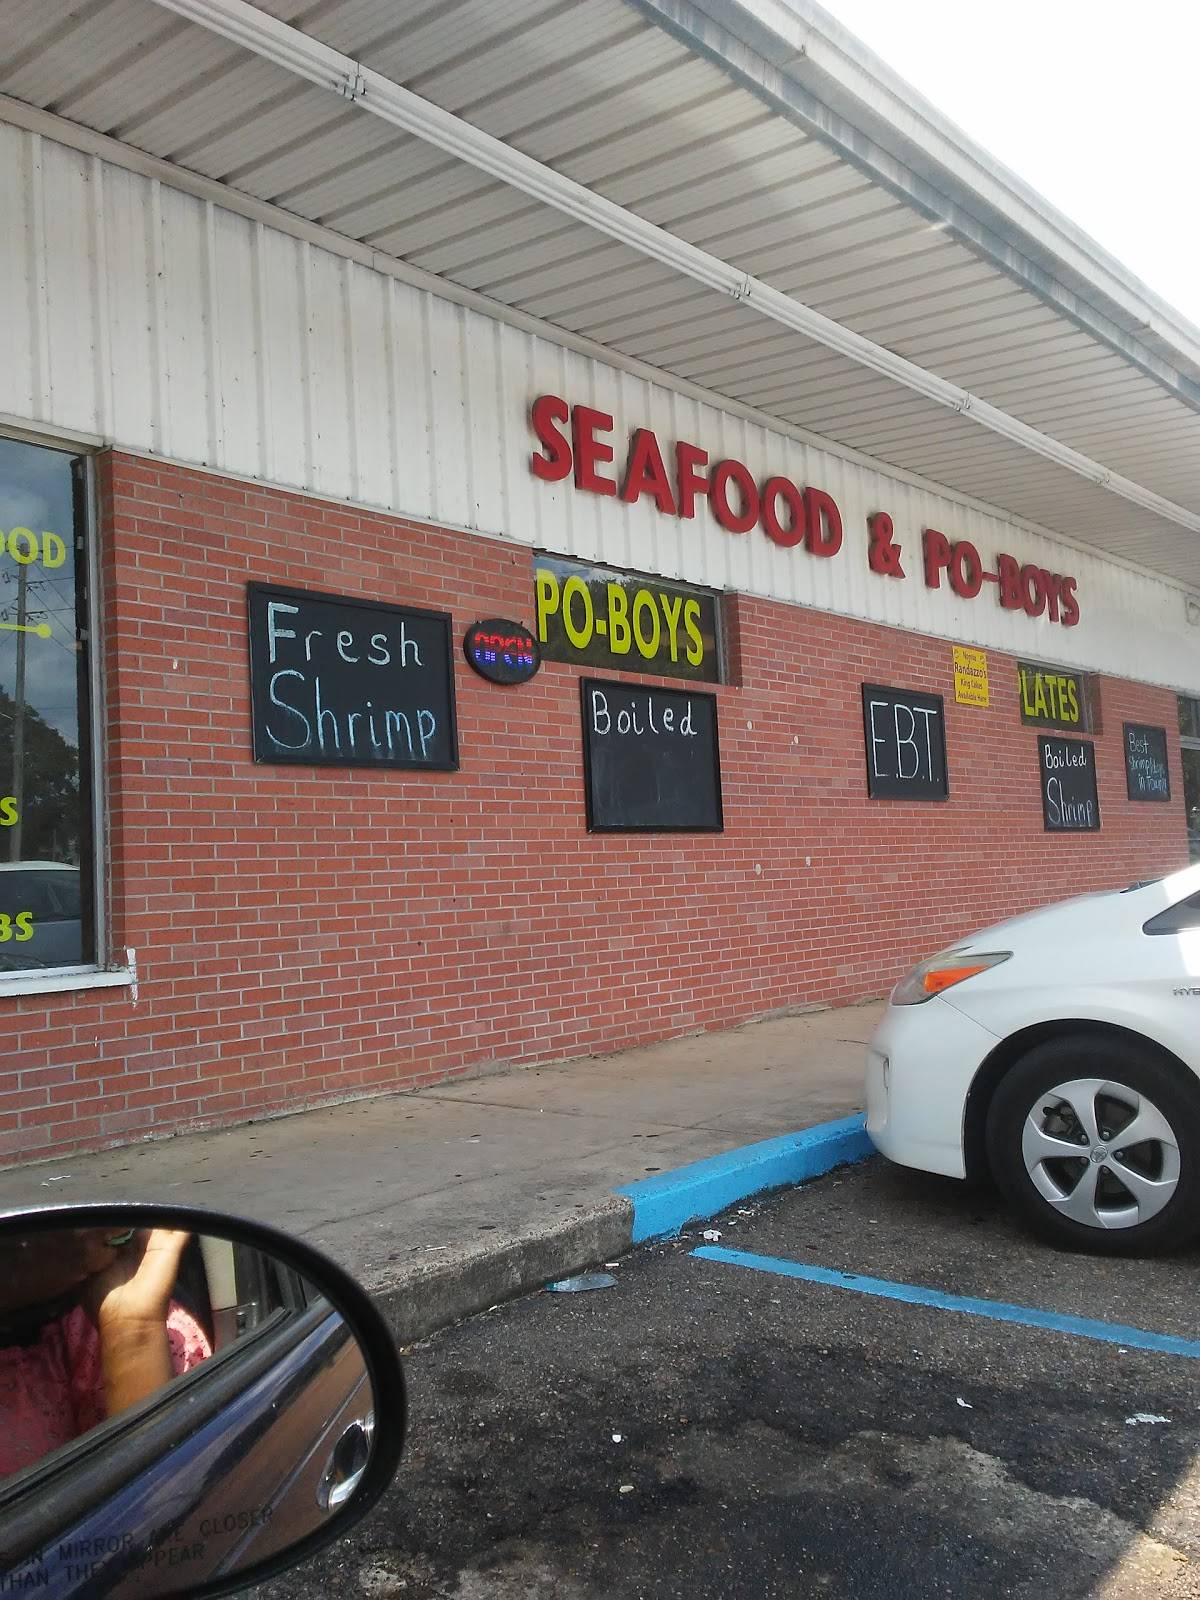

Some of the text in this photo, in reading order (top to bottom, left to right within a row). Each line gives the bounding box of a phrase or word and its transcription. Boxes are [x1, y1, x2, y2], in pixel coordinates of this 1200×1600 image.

[531, 394, 1080, 627] SEAFOOD & PO-BOYS
[0, 526, 66, 569] OD
[267, 601, 424, 667] Fresh
[536, 568, 703, 666] PO-BOYS
[265, 669, 436, 760] Shrimp
[592, 690, 697, 736] Boiled
[1018, 669, 1079, 723] LATES
[1044, 743, 1087, 770] Boiled
[1128, 732, 1149, 754] Best
[1046, 776, 1094, 829] Shrimp
[59, 1533, 133, 1561] MIRROR
